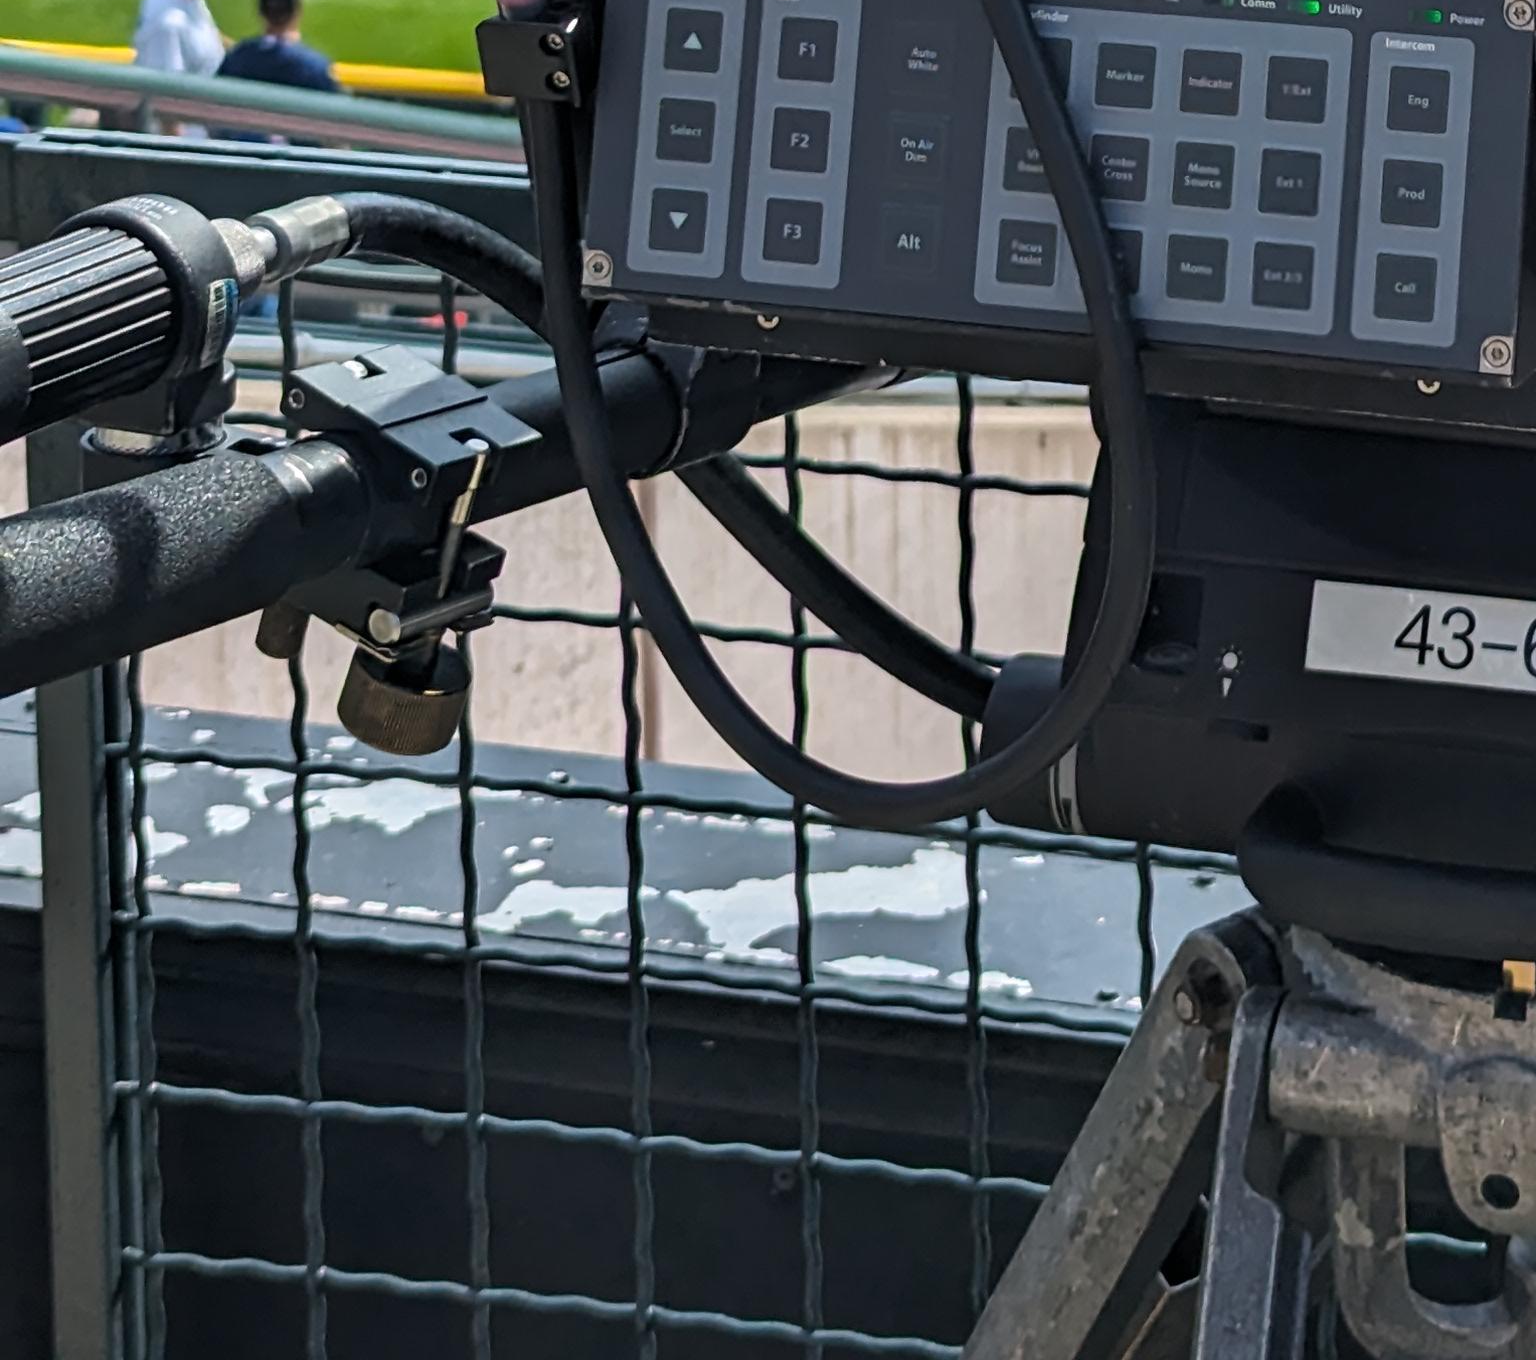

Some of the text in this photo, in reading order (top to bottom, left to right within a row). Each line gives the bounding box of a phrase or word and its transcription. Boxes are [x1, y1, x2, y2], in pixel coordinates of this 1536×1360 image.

[1328, 3, 1363, 19] Utility
[1449, 13, 1485, 27] Power
[799, 42, 817, 57] F1
[1385, 37, 1436, 52] Intercom
[911, 47, 938, 59] Auto
[908, 60, 940, 73] White
[1188, 76, 1233, 90] Indicator
[1407, 94, 1429, 109] Eng
[670, 124, 702, 137] Select
[790, 133, 810, 148] F2
[900, 137, 935, 150] On Air
[1397, 187, 1426, 201] Prod
[783, 224, 802, 240] F3
[897, 234, 921, 250] Alt
[1394, 282, 1416, 294] Call
